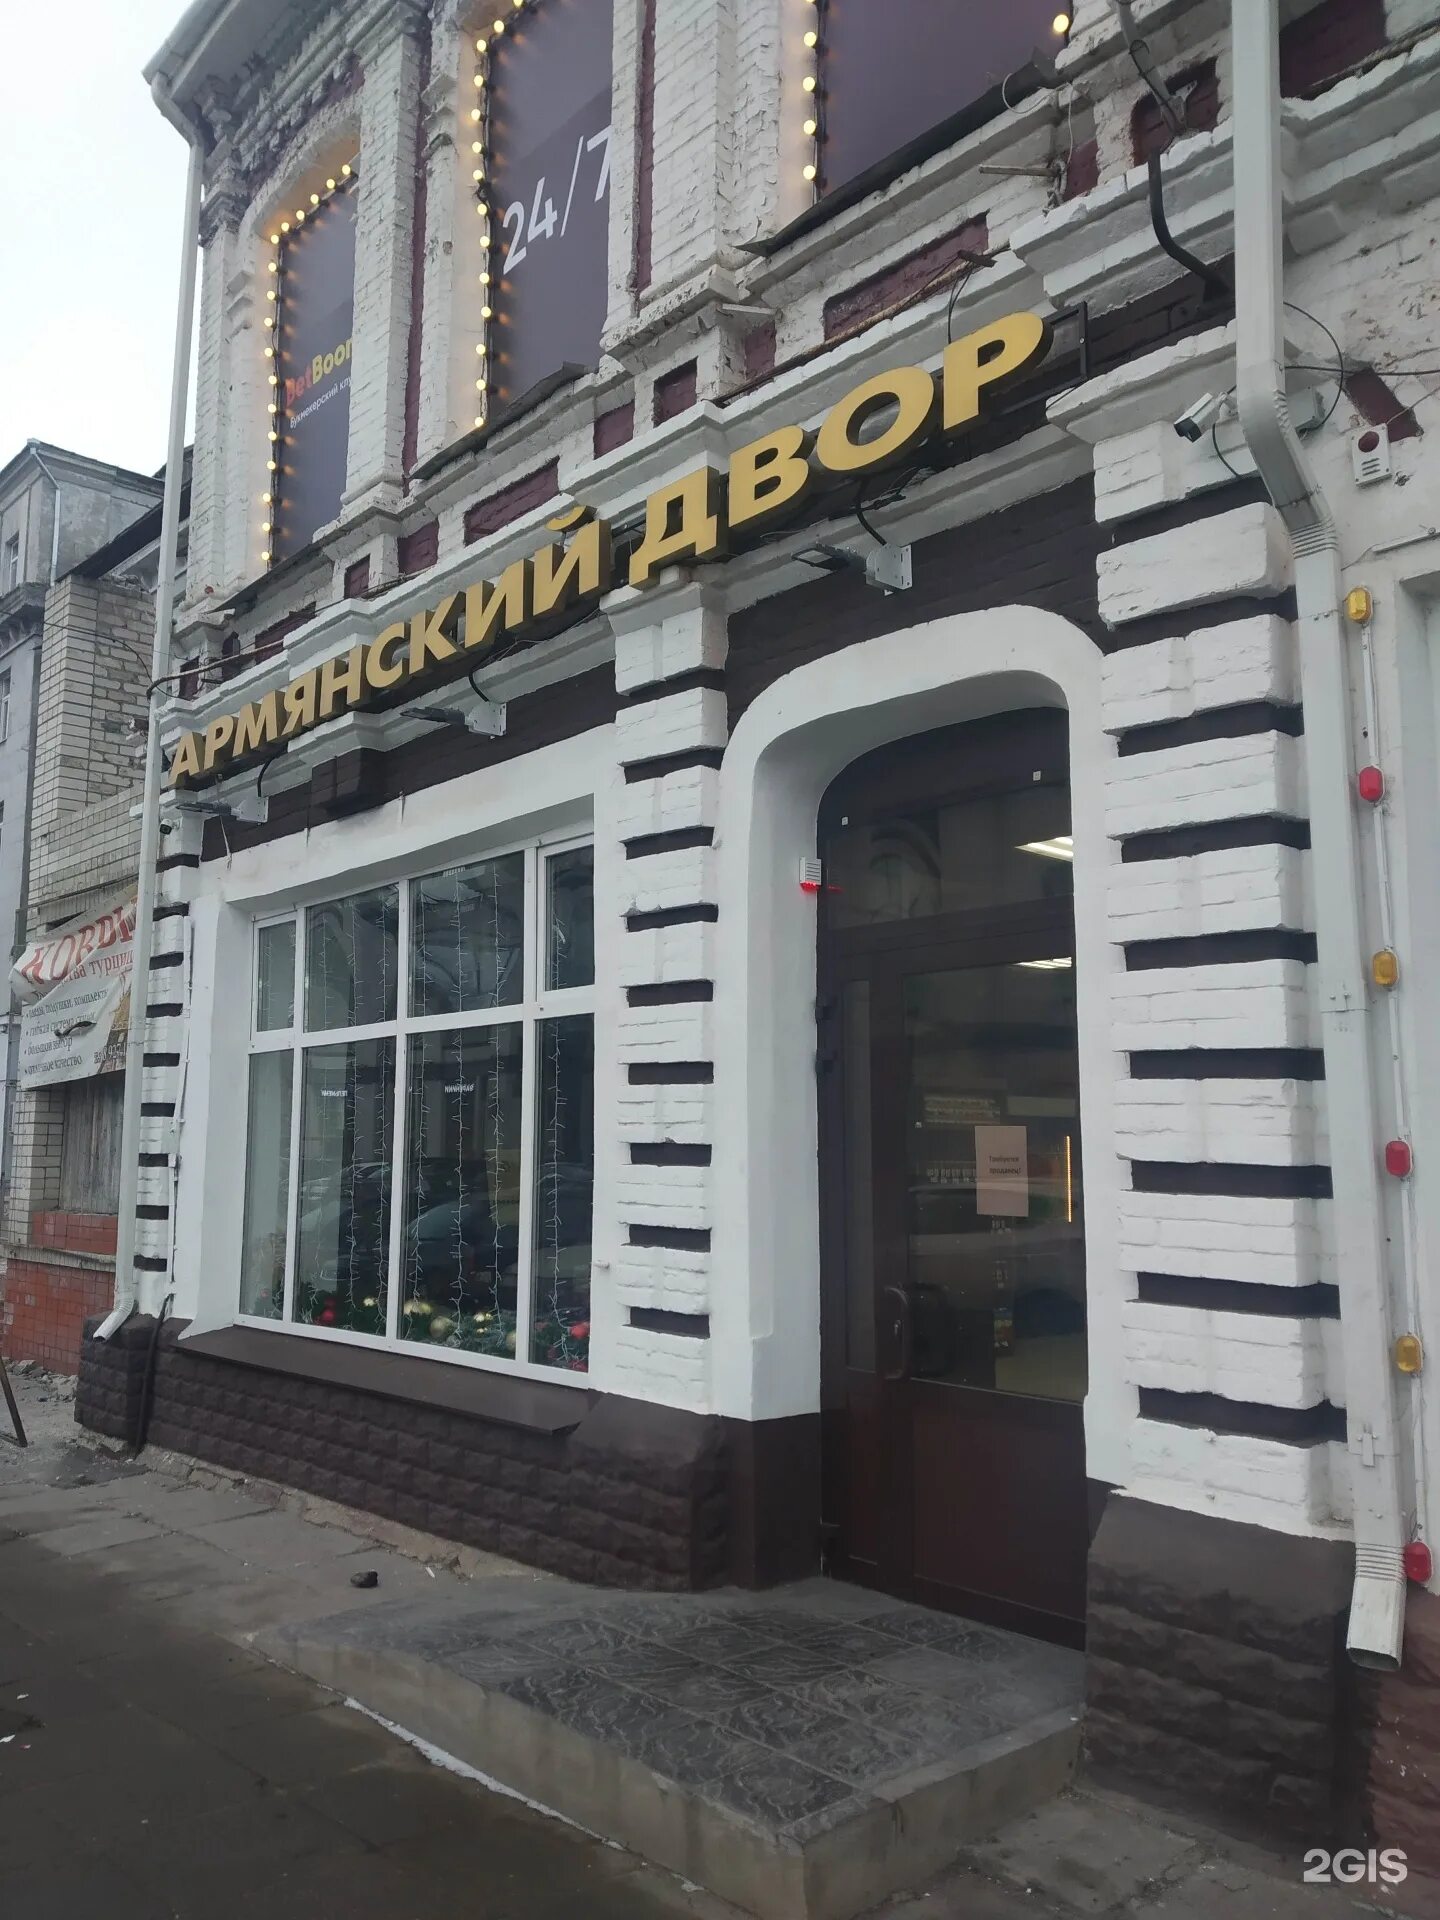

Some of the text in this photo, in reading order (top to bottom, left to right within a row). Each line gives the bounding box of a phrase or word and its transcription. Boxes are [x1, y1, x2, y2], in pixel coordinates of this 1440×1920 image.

[502, 125, 612, 275] 24/7
[290, 383, 338, 429] букмекерский
[166, 310, 1056, 788] АРМЯНСКИЙ ДВОР
